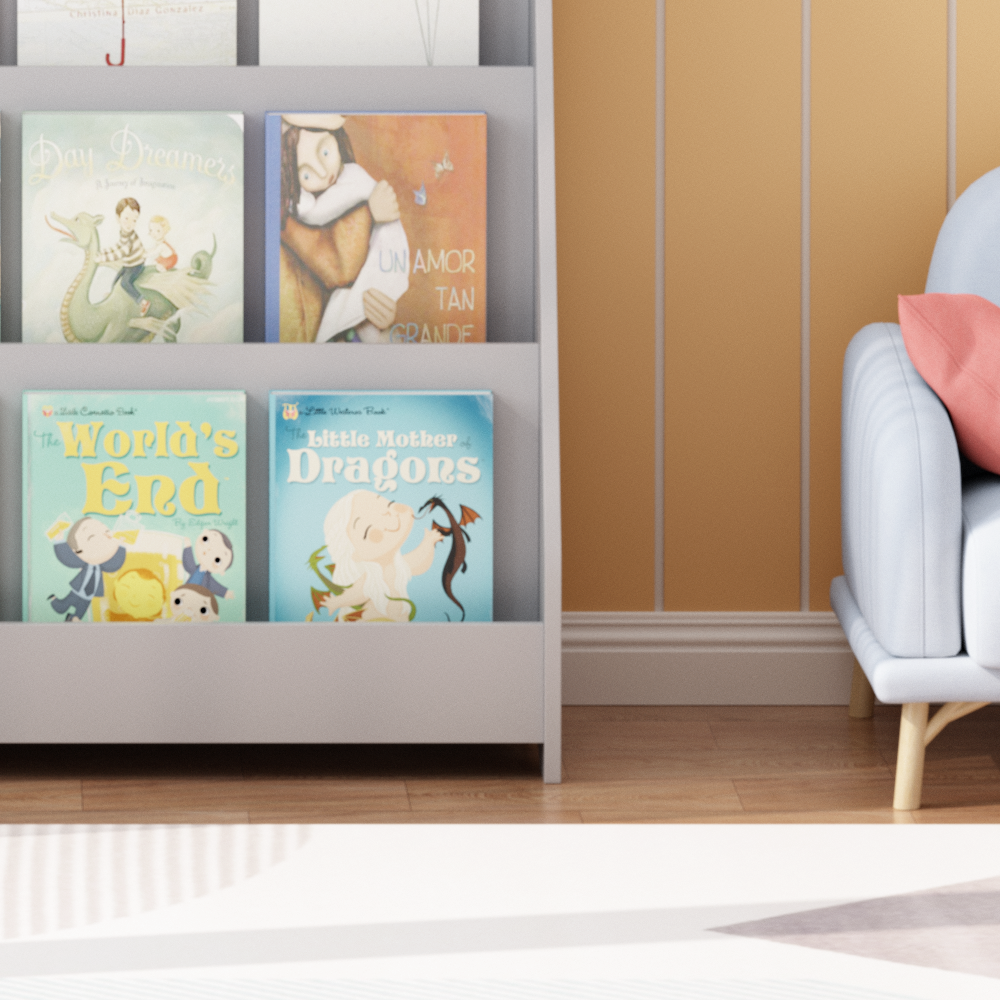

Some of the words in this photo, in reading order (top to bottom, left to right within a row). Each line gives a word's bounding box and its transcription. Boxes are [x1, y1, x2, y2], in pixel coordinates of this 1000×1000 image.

[28, 133, 94, 186] Day
[105, 122, 237, 185] Dreamers
[378, 248, 407, 274] UN
[413, 248, 476, 275] AMOR
[434, 285, 475, 312] TAN
[389, 321, 475, 343] GRANDE
[56, 420, 240, 458] World's
[306, 429, 371, 449] Little
[375, 429, 458, 449] Mother
[286, 447, 482, 493] Dragons
[80, 461, 223, 517] End
